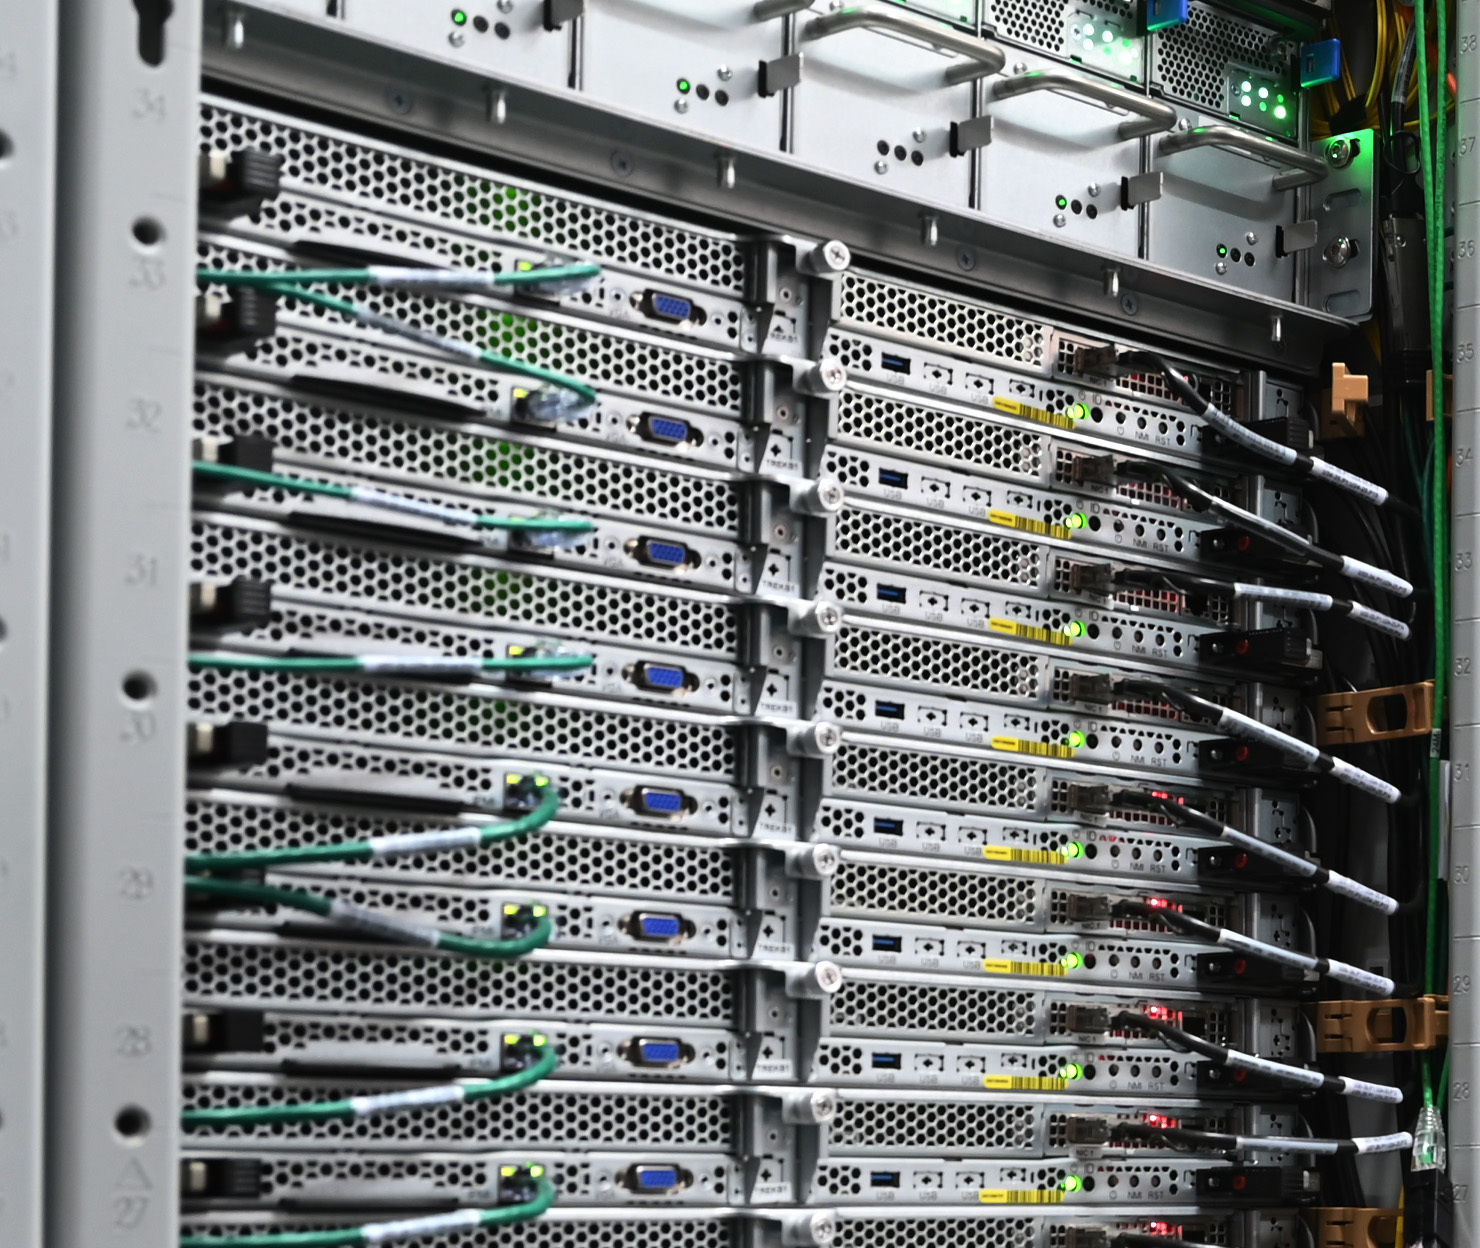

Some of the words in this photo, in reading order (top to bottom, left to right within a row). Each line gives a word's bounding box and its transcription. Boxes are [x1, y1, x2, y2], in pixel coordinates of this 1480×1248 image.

[1460, 34, 1478, 54] 38
[1459, 136, 1476, 156] 37
[1458, 240, 1475, 259] 36
[1457, 343, 1474, 363] 35
[1456, 448, 1474, 466] 34
[1455, 552, 1472, 572] 33
[1454, 657, 1472, 676] 32
[1454, 864, 1470, 884] 30
[1453, 974, 1471, 995] 29
[1453, 1081, 1470, 1102] 28
